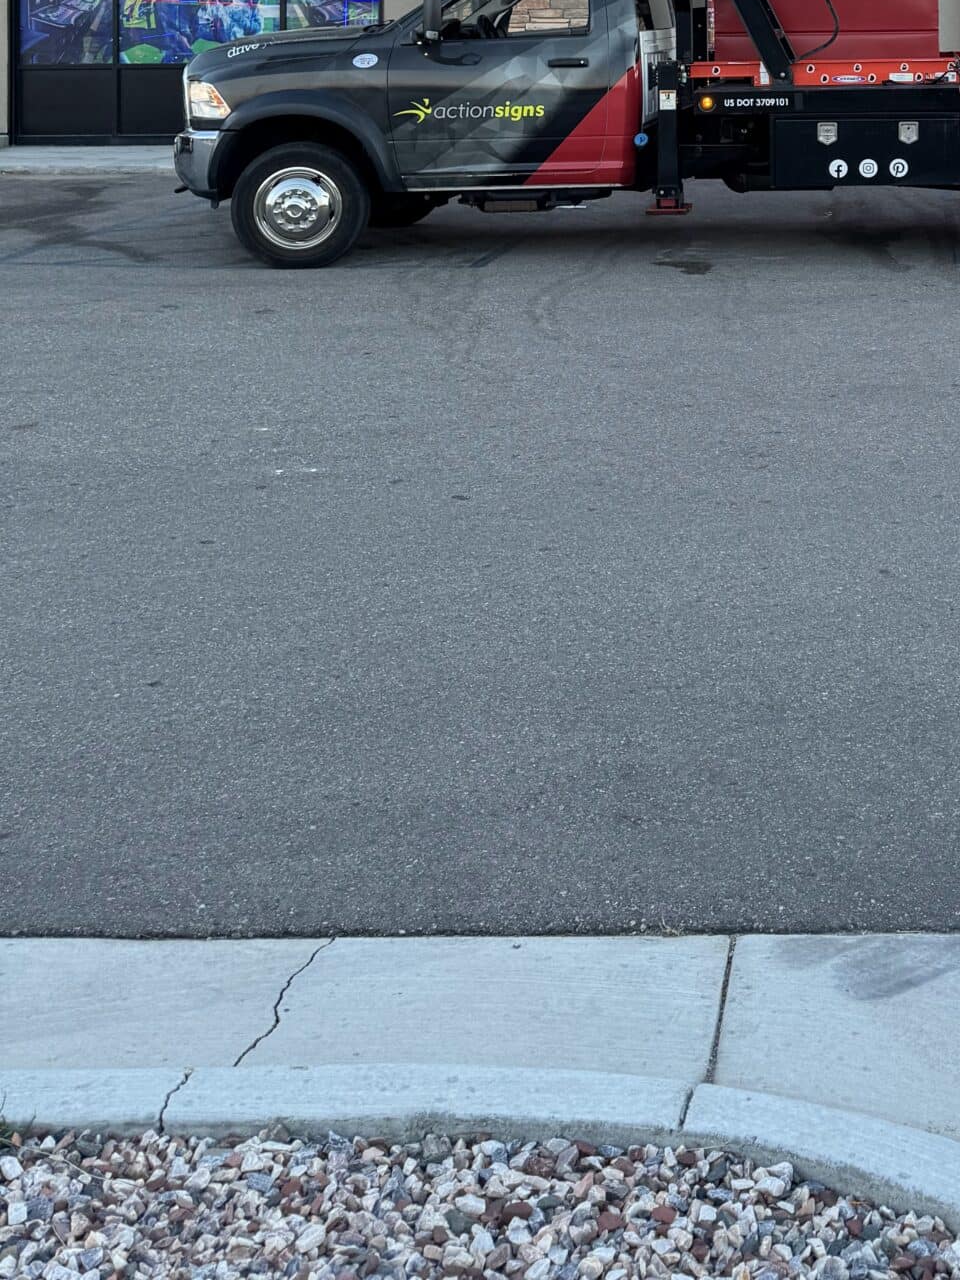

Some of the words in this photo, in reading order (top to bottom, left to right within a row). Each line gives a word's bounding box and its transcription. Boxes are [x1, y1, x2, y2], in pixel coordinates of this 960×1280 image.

[227, 43, 260, 58] drive
[724, 98, 735, 107] US
[736, 98, 755, 107] DOT
[755, 97, 790, 107] 3709101
[433, 100, 545, 121] actionsigns
